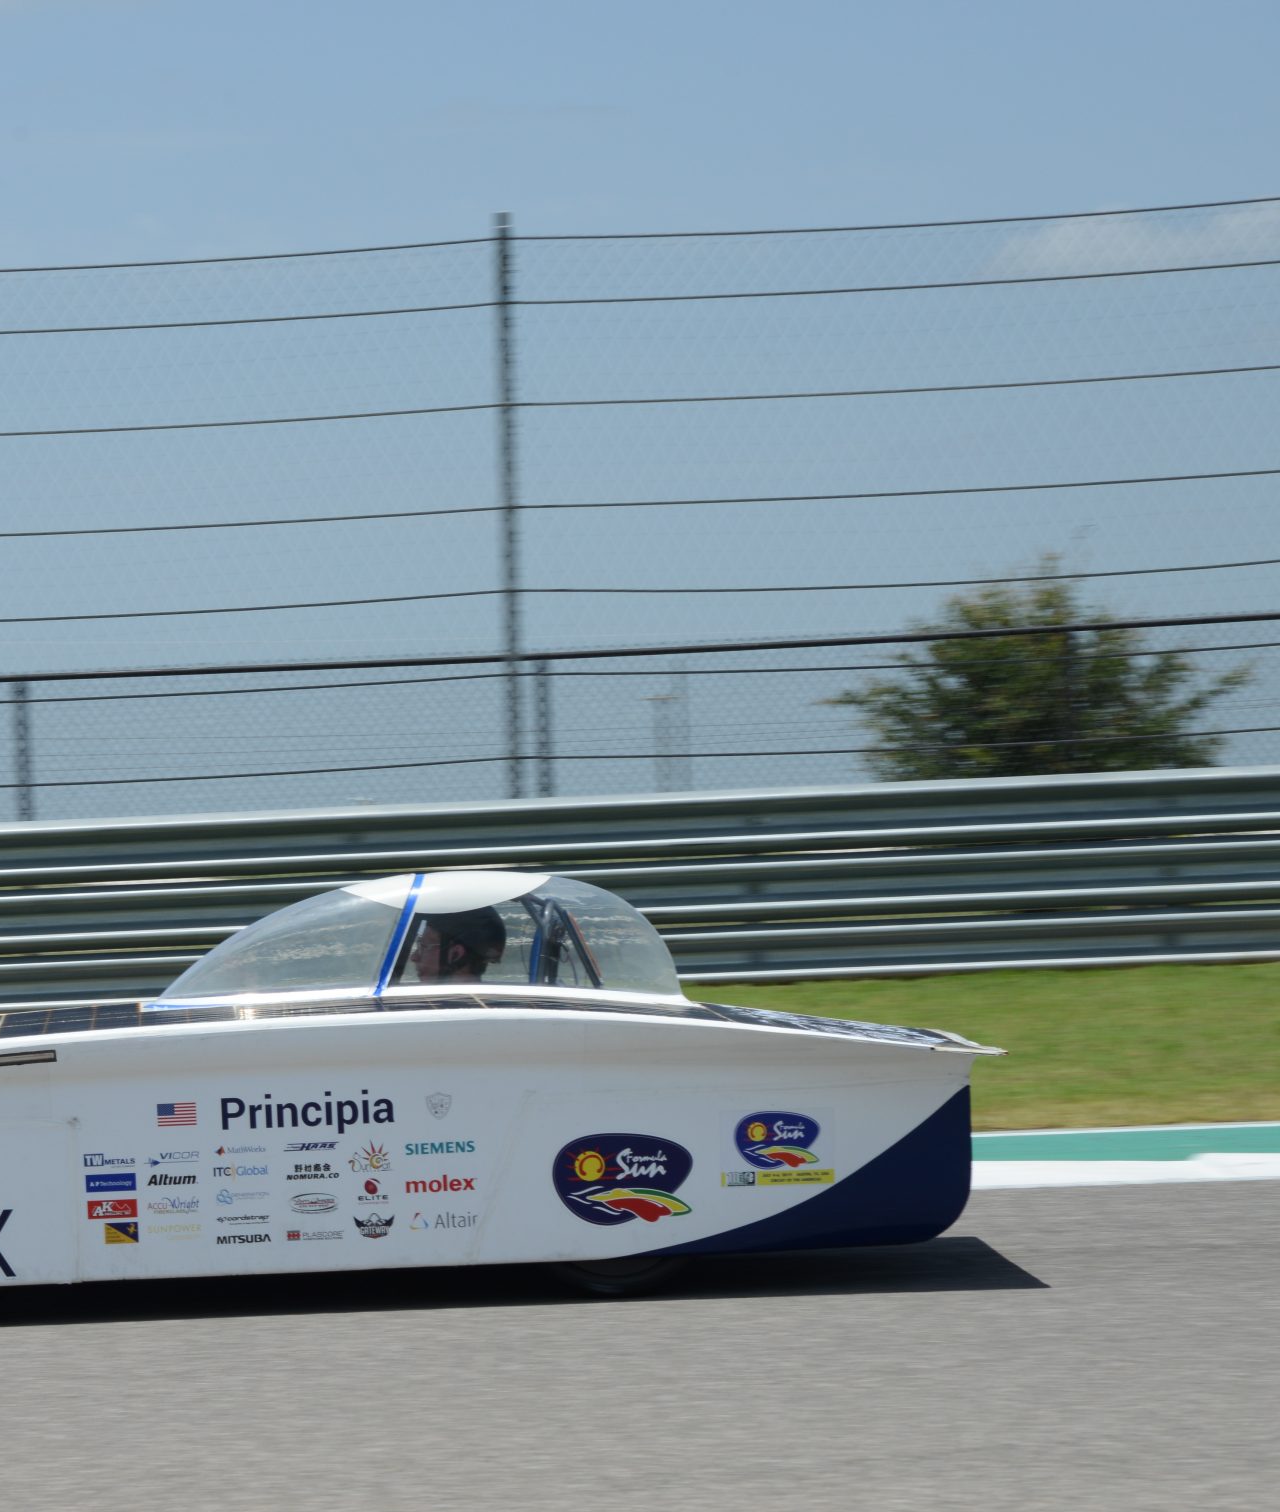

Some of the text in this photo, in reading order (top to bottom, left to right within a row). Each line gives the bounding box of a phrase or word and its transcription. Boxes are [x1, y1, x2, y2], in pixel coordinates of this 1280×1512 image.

[220, 1089, 395, 1134] Principia
[405, 1141, 475, 1155] SIEMENS
[160, 1151, 200, 1160] VICOR
[626, 1150, 668, 1163] Formula
[616, 1148, 667, 1180] Sun
[213, 1165, 268, 1177] ITC Global
[147, 1173, 197, 1186] Altium
[405, 1174, 476, 1193] molex
[434, 1211, 478, 1229] Altair
[216, 1233, 271, 1244] MITSUBA
